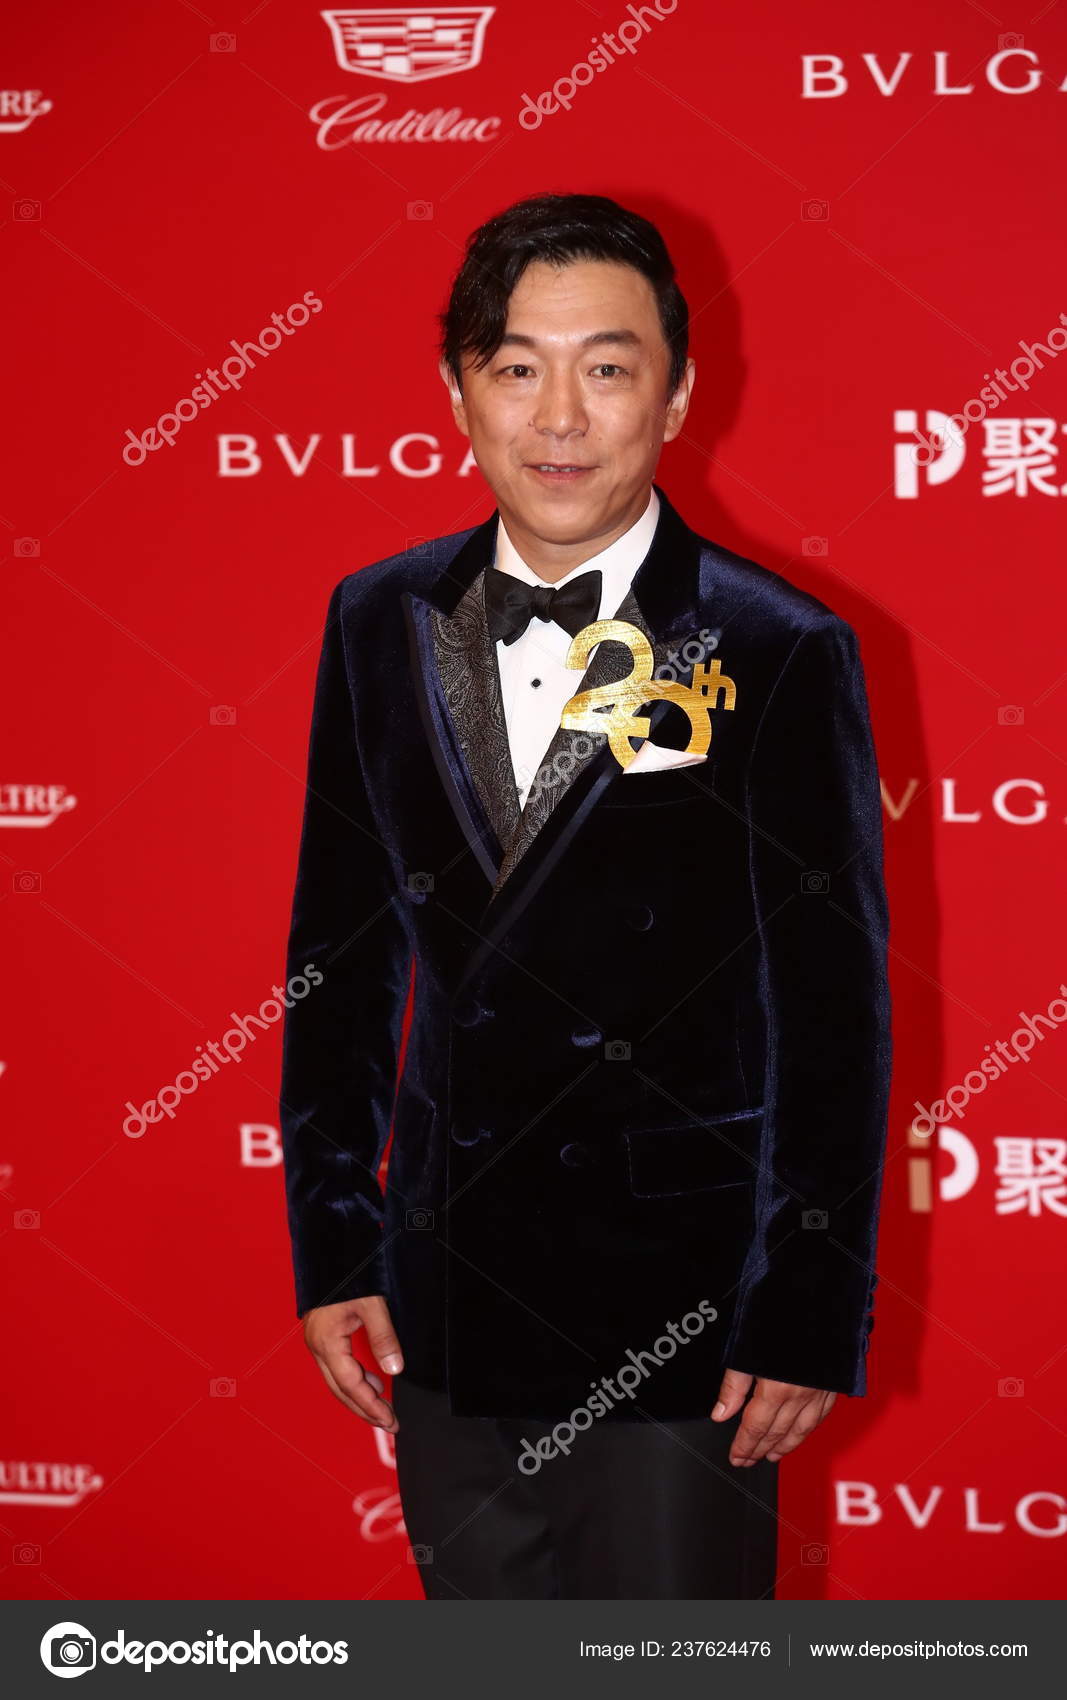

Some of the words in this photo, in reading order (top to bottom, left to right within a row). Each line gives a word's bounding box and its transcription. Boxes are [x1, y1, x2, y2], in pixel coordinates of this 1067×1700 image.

[801, 48, 1067, 98] BVLG
[309, 92, 501, 151] Cadillac
[982, 417, 1067, 498] 聚
[880, 778, 1067, 825] VLG
[834, 1480, 1067, 1538] BVLG
